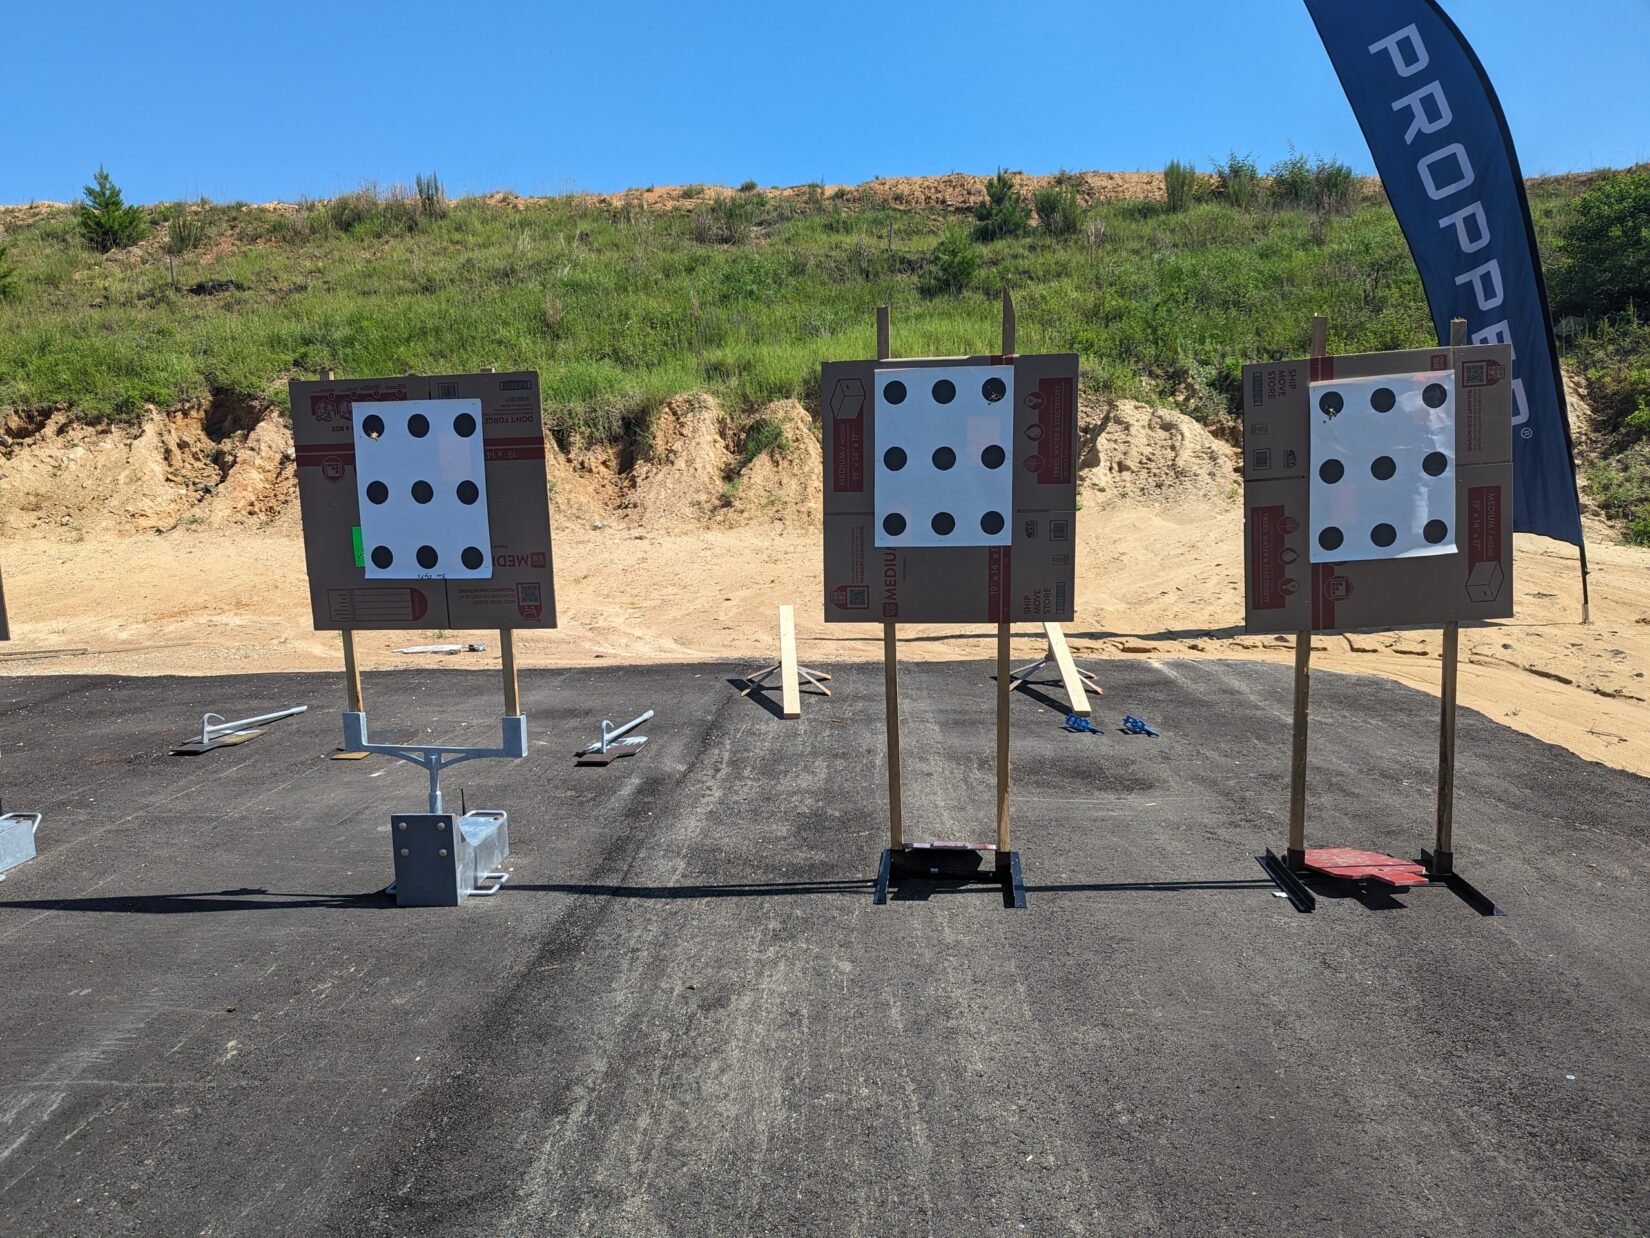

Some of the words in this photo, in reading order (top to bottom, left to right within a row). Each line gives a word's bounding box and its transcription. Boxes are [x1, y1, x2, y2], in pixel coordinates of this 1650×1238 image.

[1267, 370, 1277, 400] STORE
[1278, 370, 1287, 398] MOVE
[1289, 368, 1297, 390] SHIP
[510, 415, 534, 424] DON'T
[1487, 493, 1496, 529] MEDIUM
[884, 547, 897, 601] MEDIU
[1023, 595, 1032, 615] SHIP
[1033, 588, 1042, 614] MOVE
[1043, 586, 1052, 615] STORE
